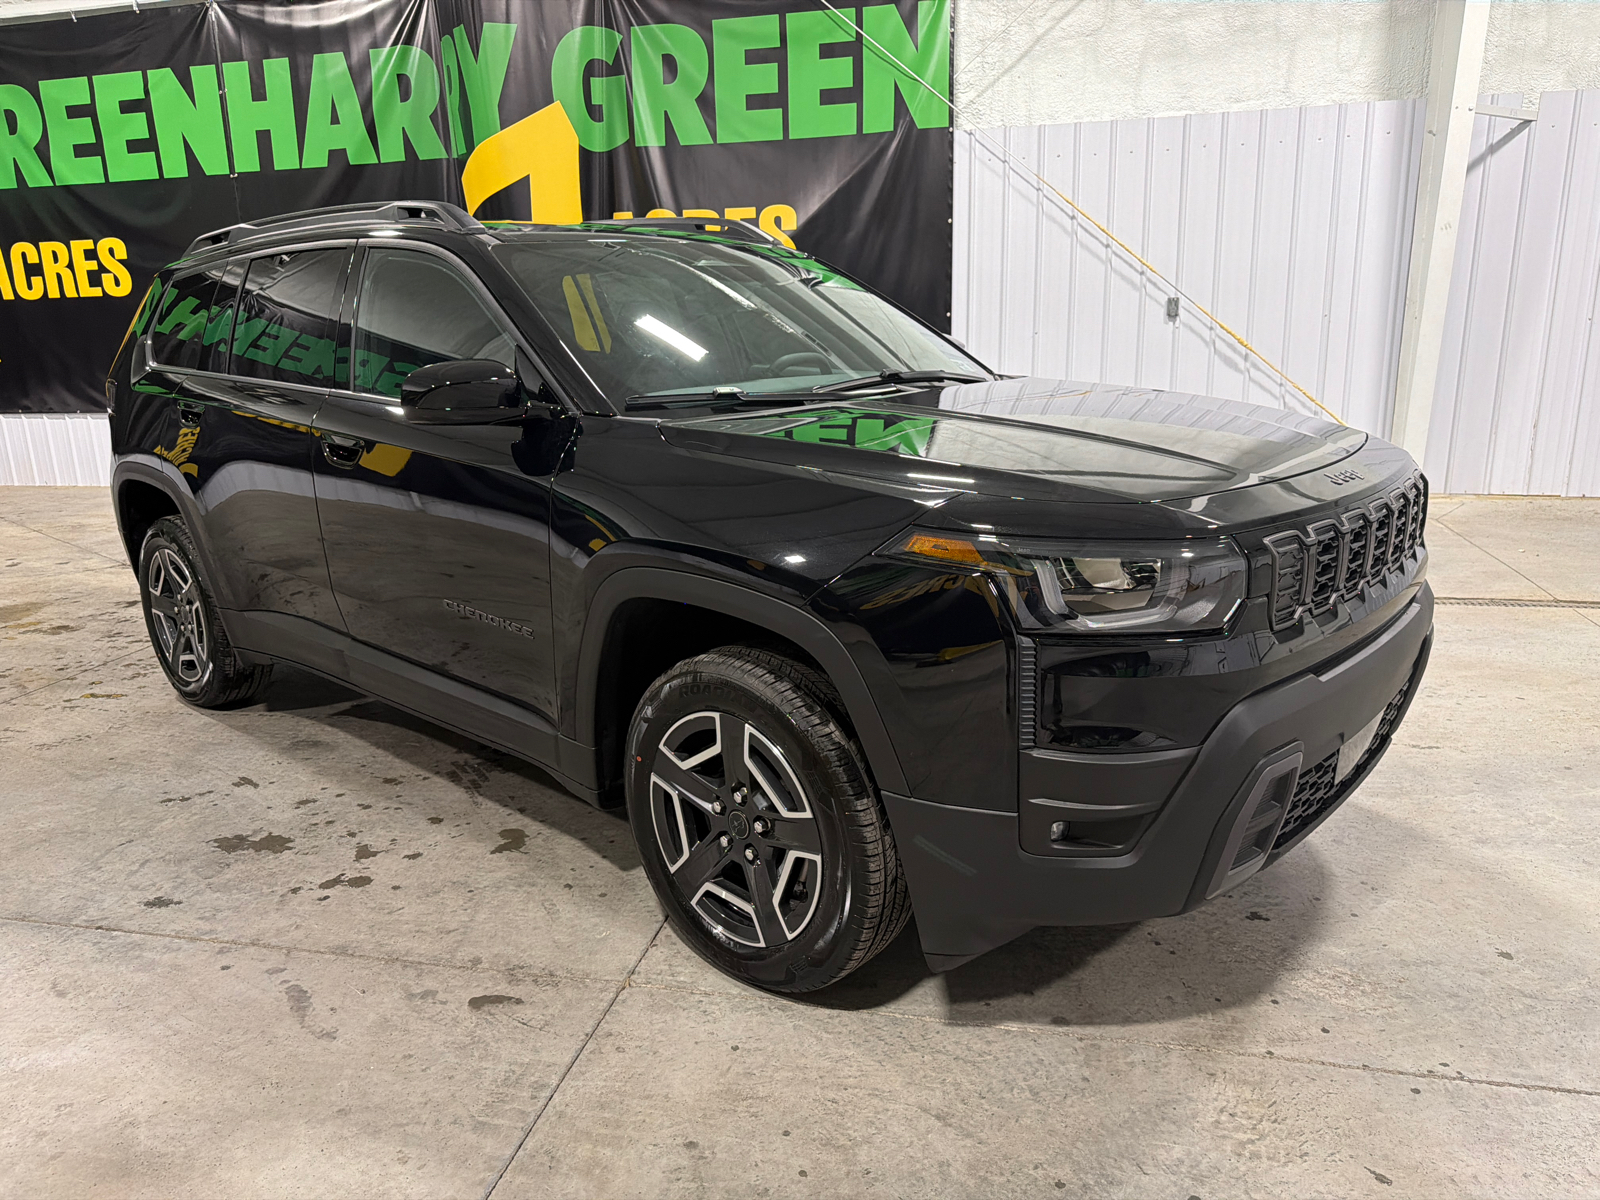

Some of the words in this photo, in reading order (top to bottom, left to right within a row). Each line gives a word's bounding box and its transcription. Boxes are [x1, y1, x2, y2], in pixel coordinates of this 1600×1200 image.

[551, 3, 949, 153] GREEN
[1323, 468, 1365, 486] Jeep
[443, 599, 535, 639] CHEROKEE
